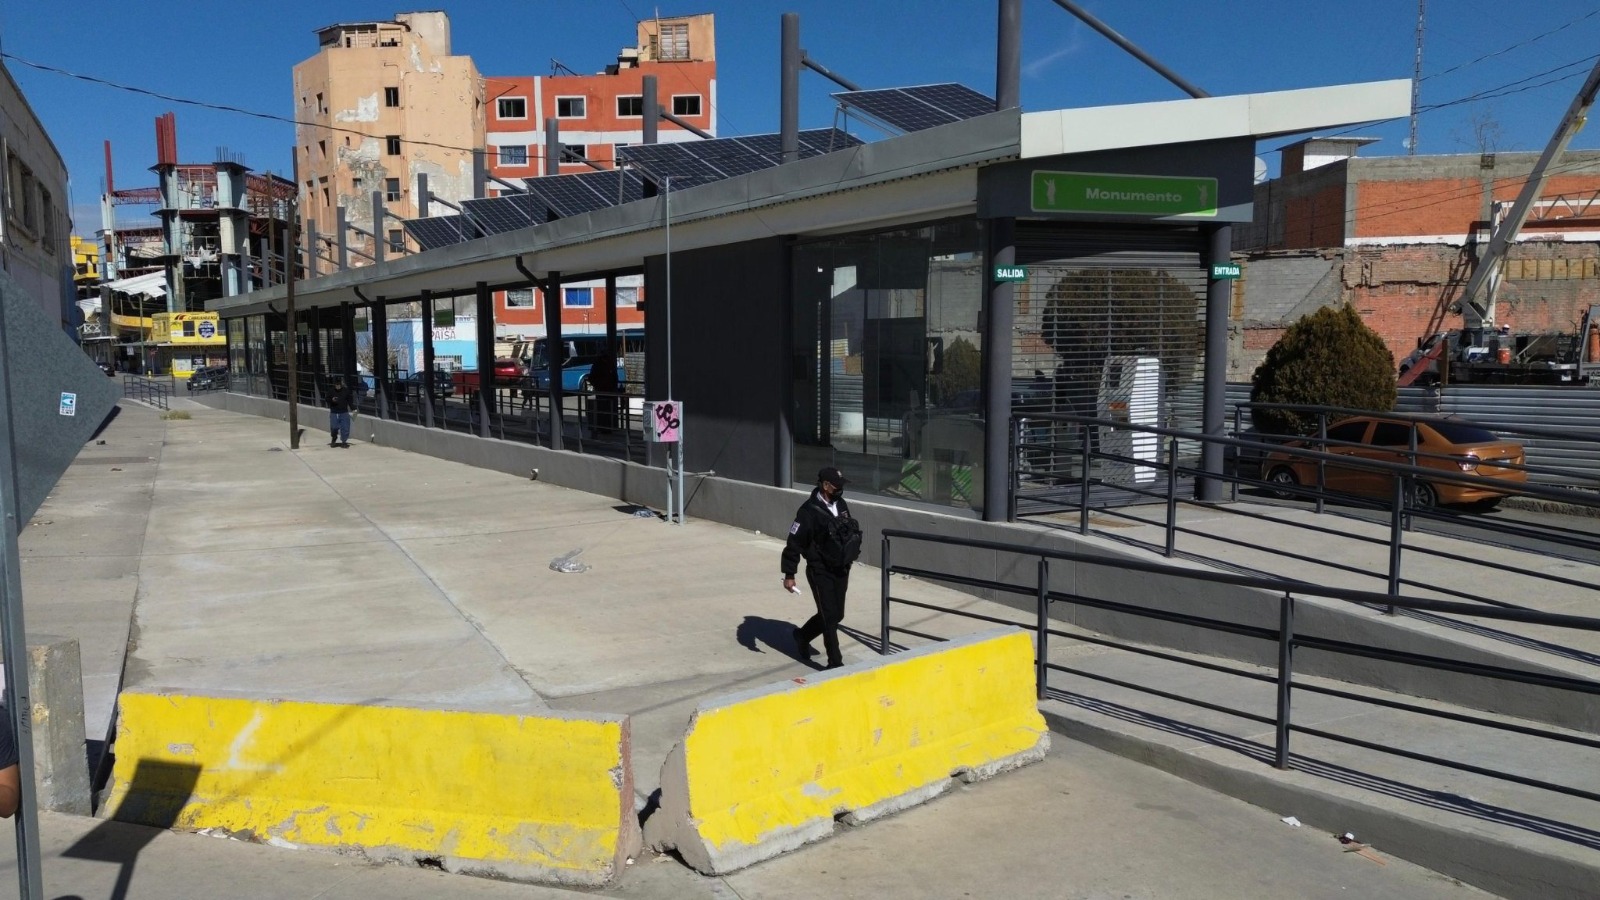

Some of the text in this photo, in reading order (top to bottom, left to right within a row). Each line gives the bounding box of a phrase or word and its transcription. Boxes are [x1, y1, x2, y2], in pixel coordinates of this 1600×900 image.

[1086, 188, 1182, 202] Monumento
[997, 268, 1024, 278] SALIDA
[1214, 266, 1240, 276] ENTRADA
